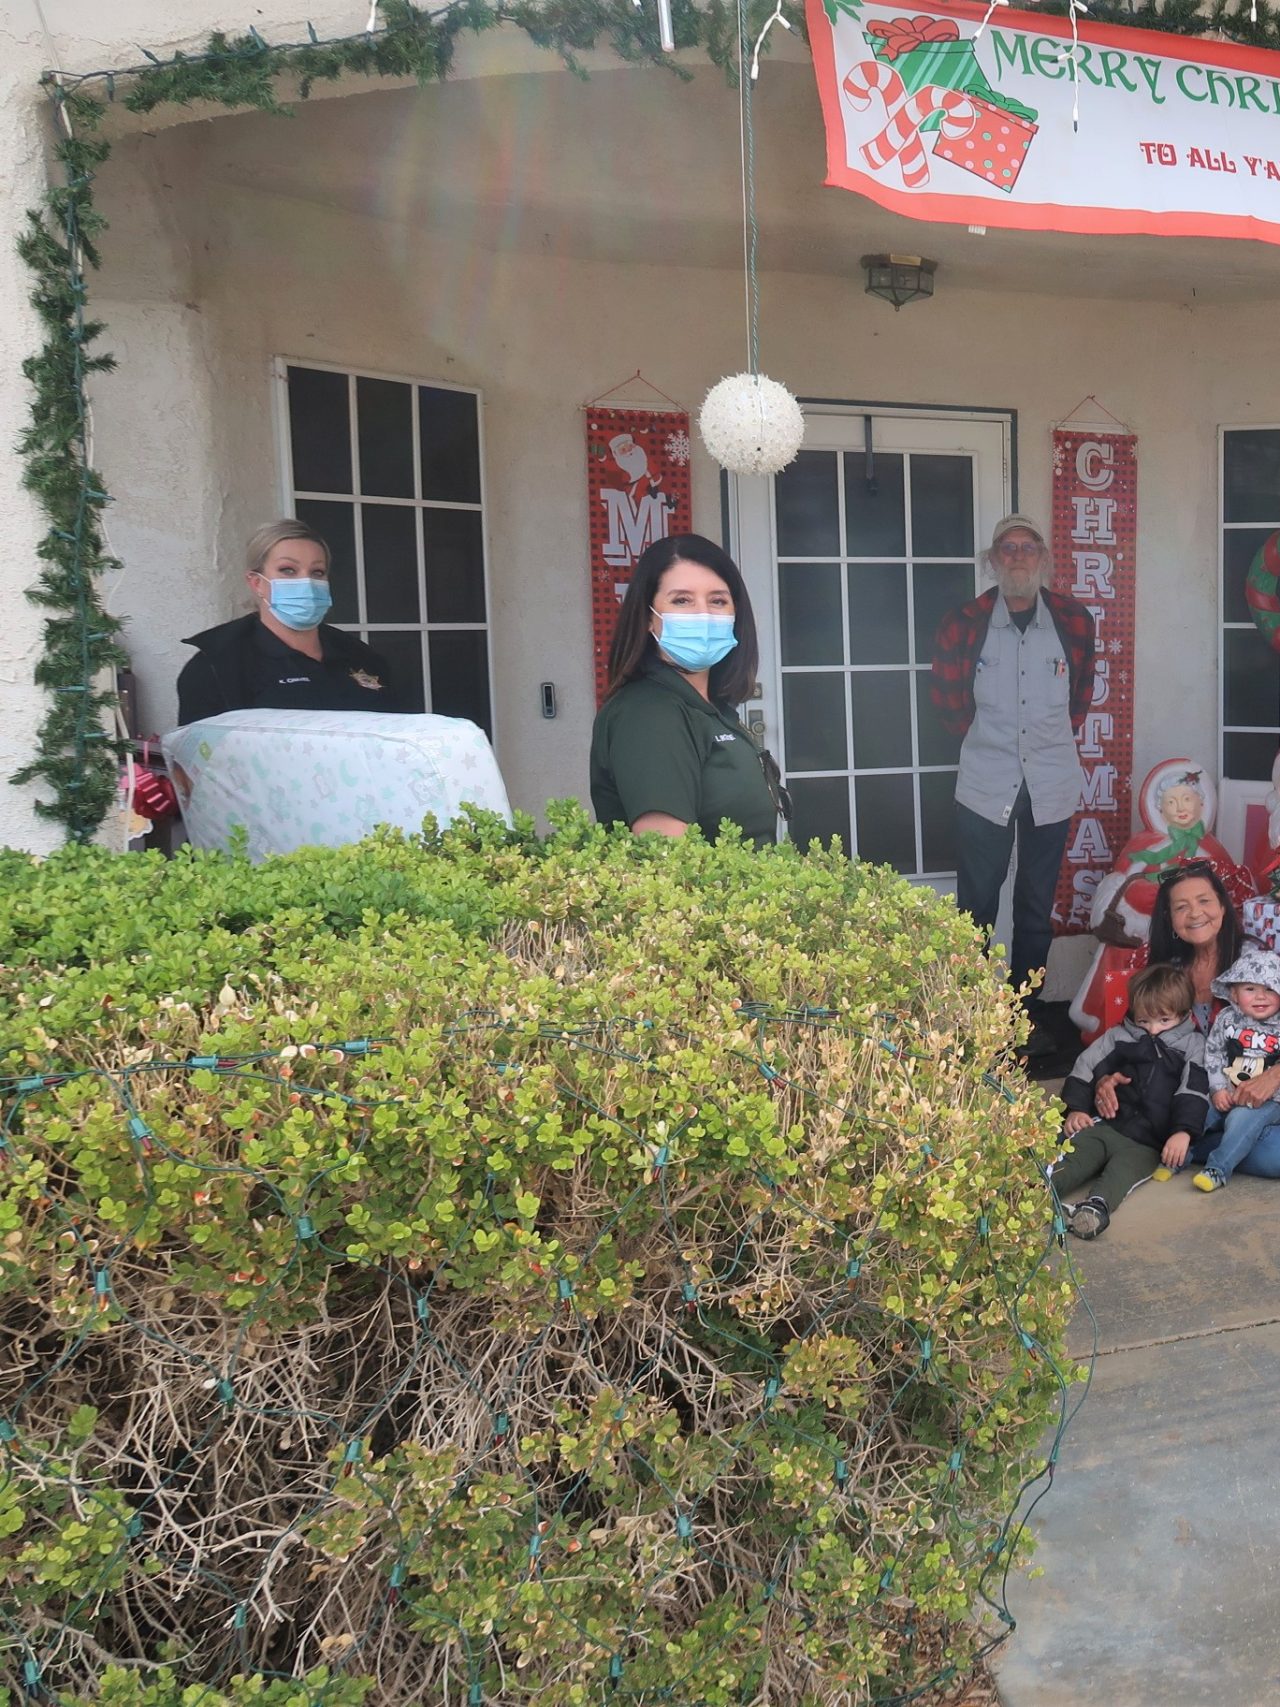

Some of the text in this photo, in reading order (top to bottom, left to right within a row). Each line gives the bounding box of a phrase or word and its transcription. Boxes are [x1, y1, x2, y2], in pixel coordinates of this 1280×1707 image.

[990, 30, 1166, 104] MERRY
[1140, 142, 1177, 166] TO
[1187, 146, 1237, 174] ALL
